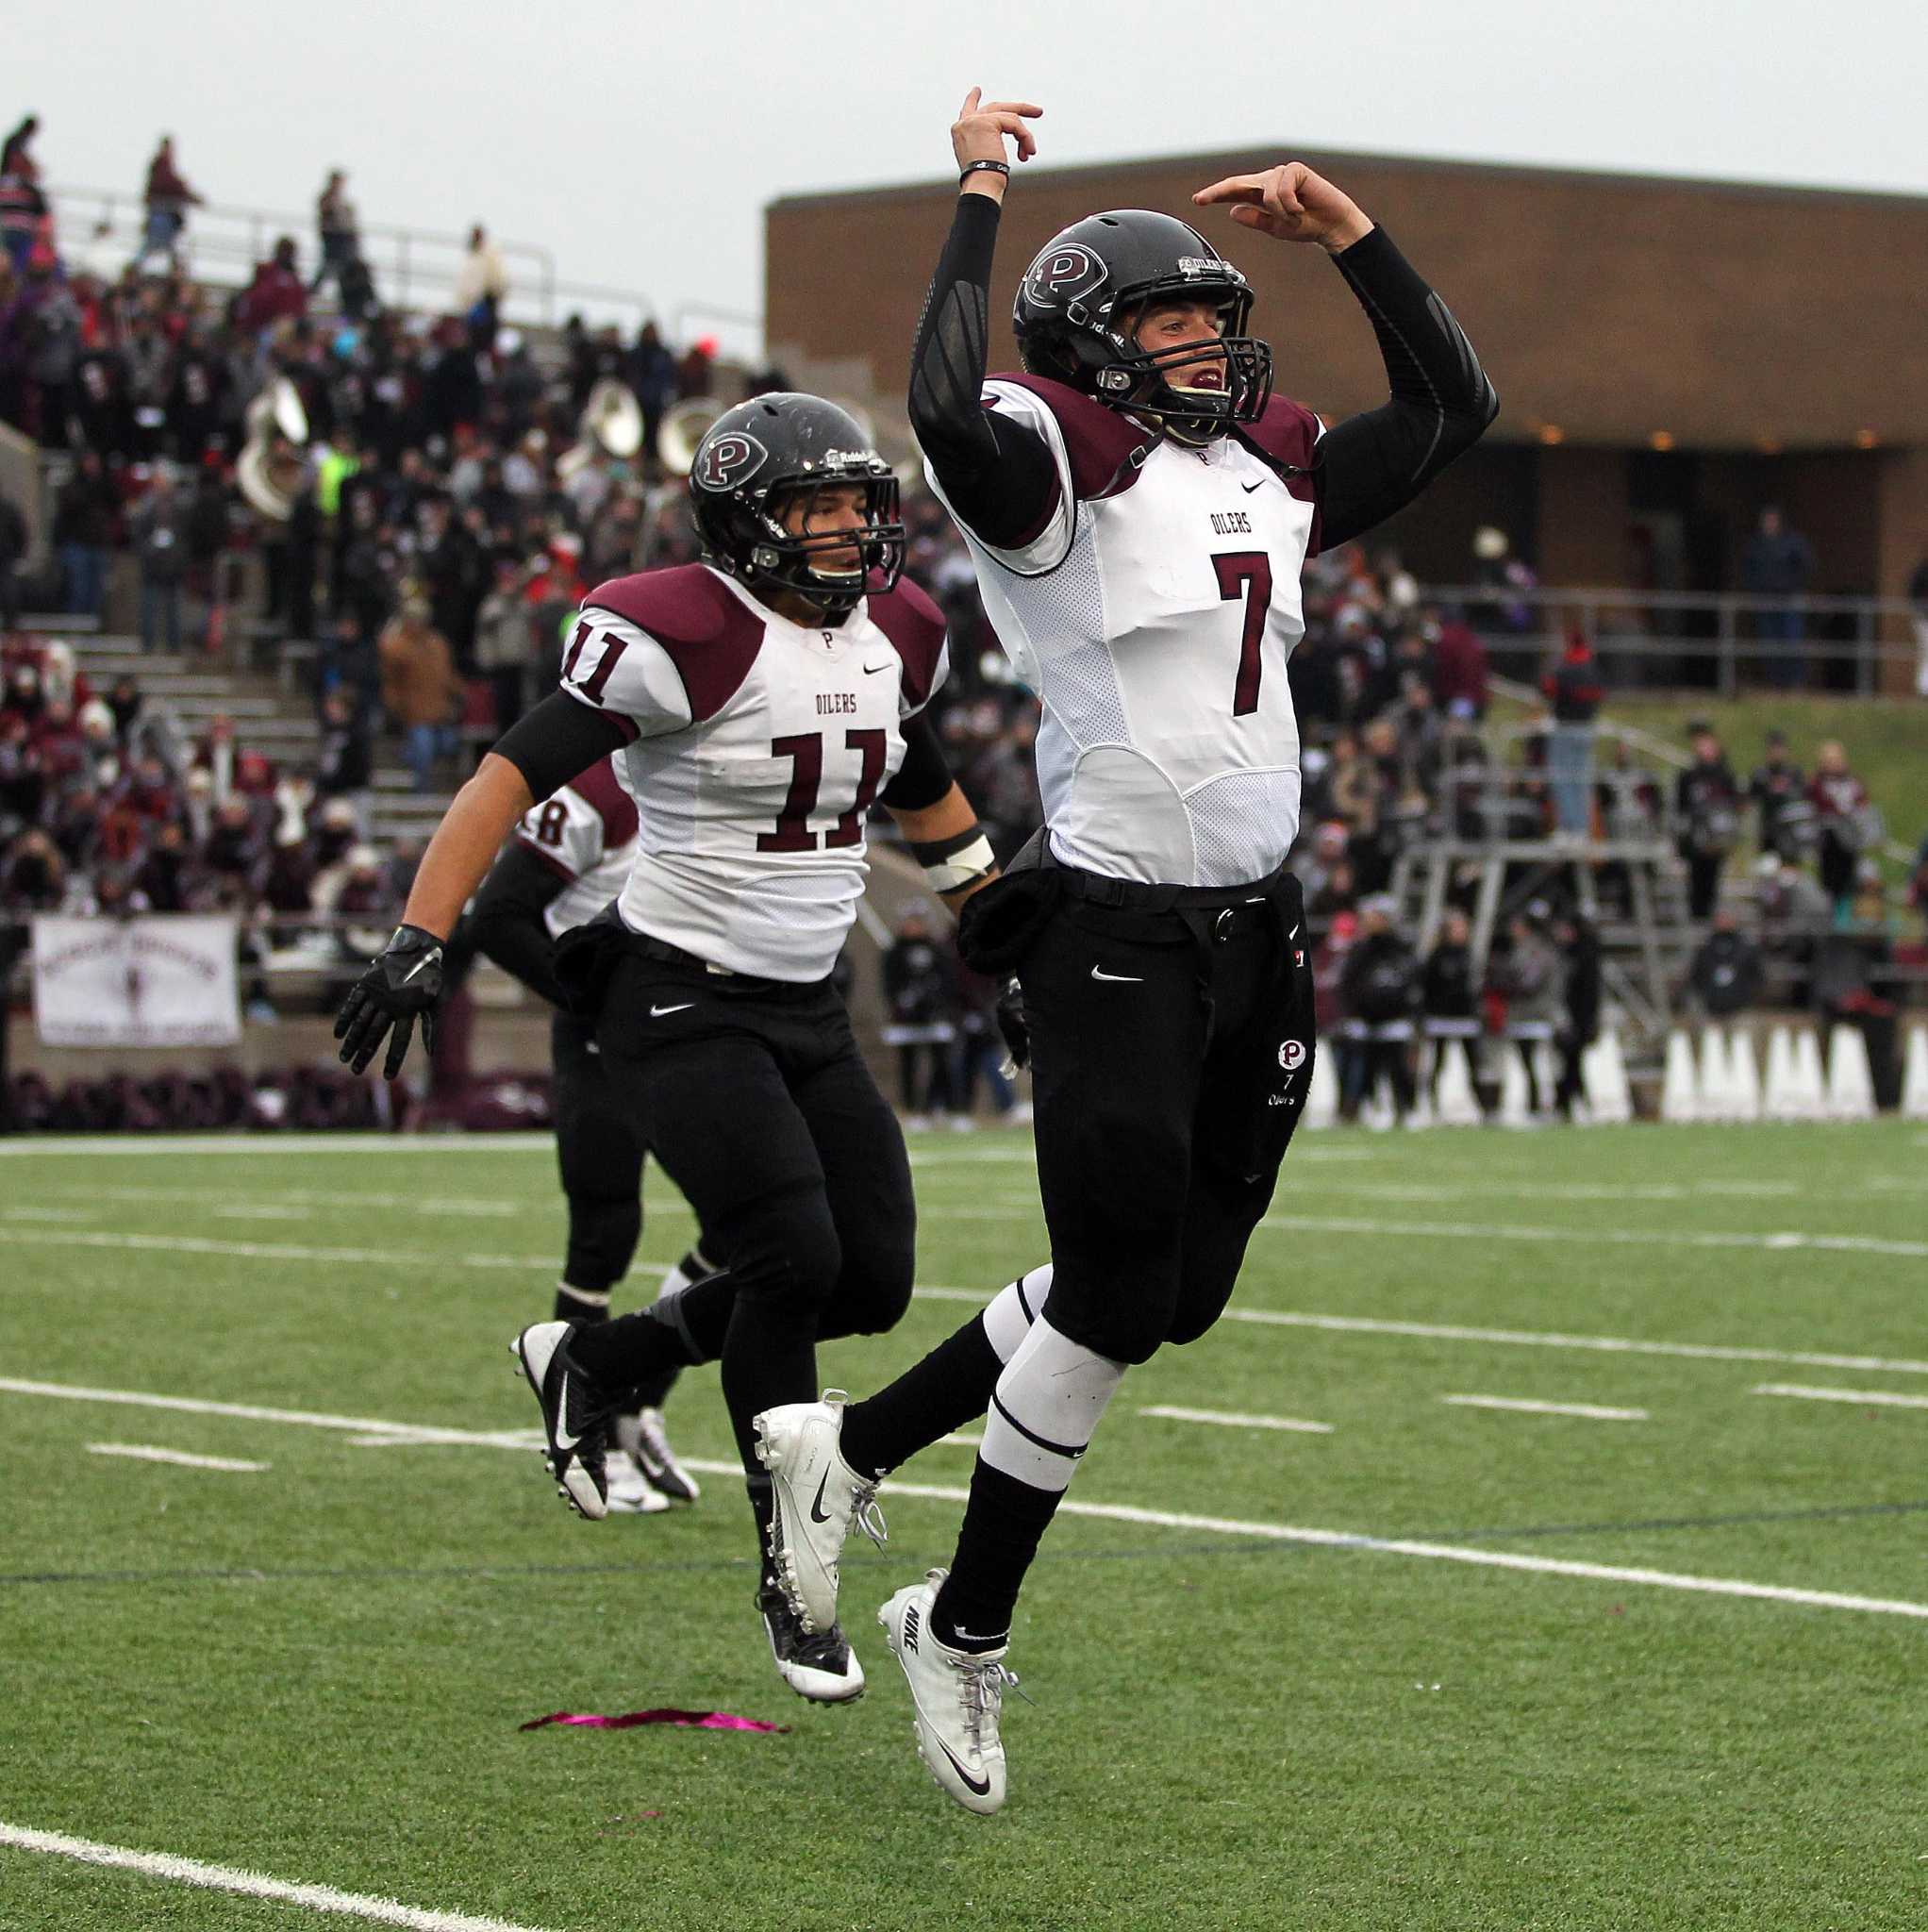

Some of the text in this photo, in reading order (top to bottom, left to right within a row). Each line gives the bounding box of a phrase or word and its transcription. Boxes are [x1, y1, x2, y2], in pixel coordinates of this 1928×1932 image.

[1032, 248, 1089, 300] P
[703, 437, 751, 486] P
[1210, 512, 1253, 535] OILERS
[821, 631, 834, 649] P
[1210, 551, 1272, 717] 7
[565, 622, 628, 707] 11
[815, 693, 857, 715] OILERS
[756, 728, 888, 852] 11
[522, 800, 569, 846] 8
[1282, 1041, 1301, 1066] P
[1284, 1074, 1294, 1091] 7
[904, 1605, 921, 1656] NIKE
